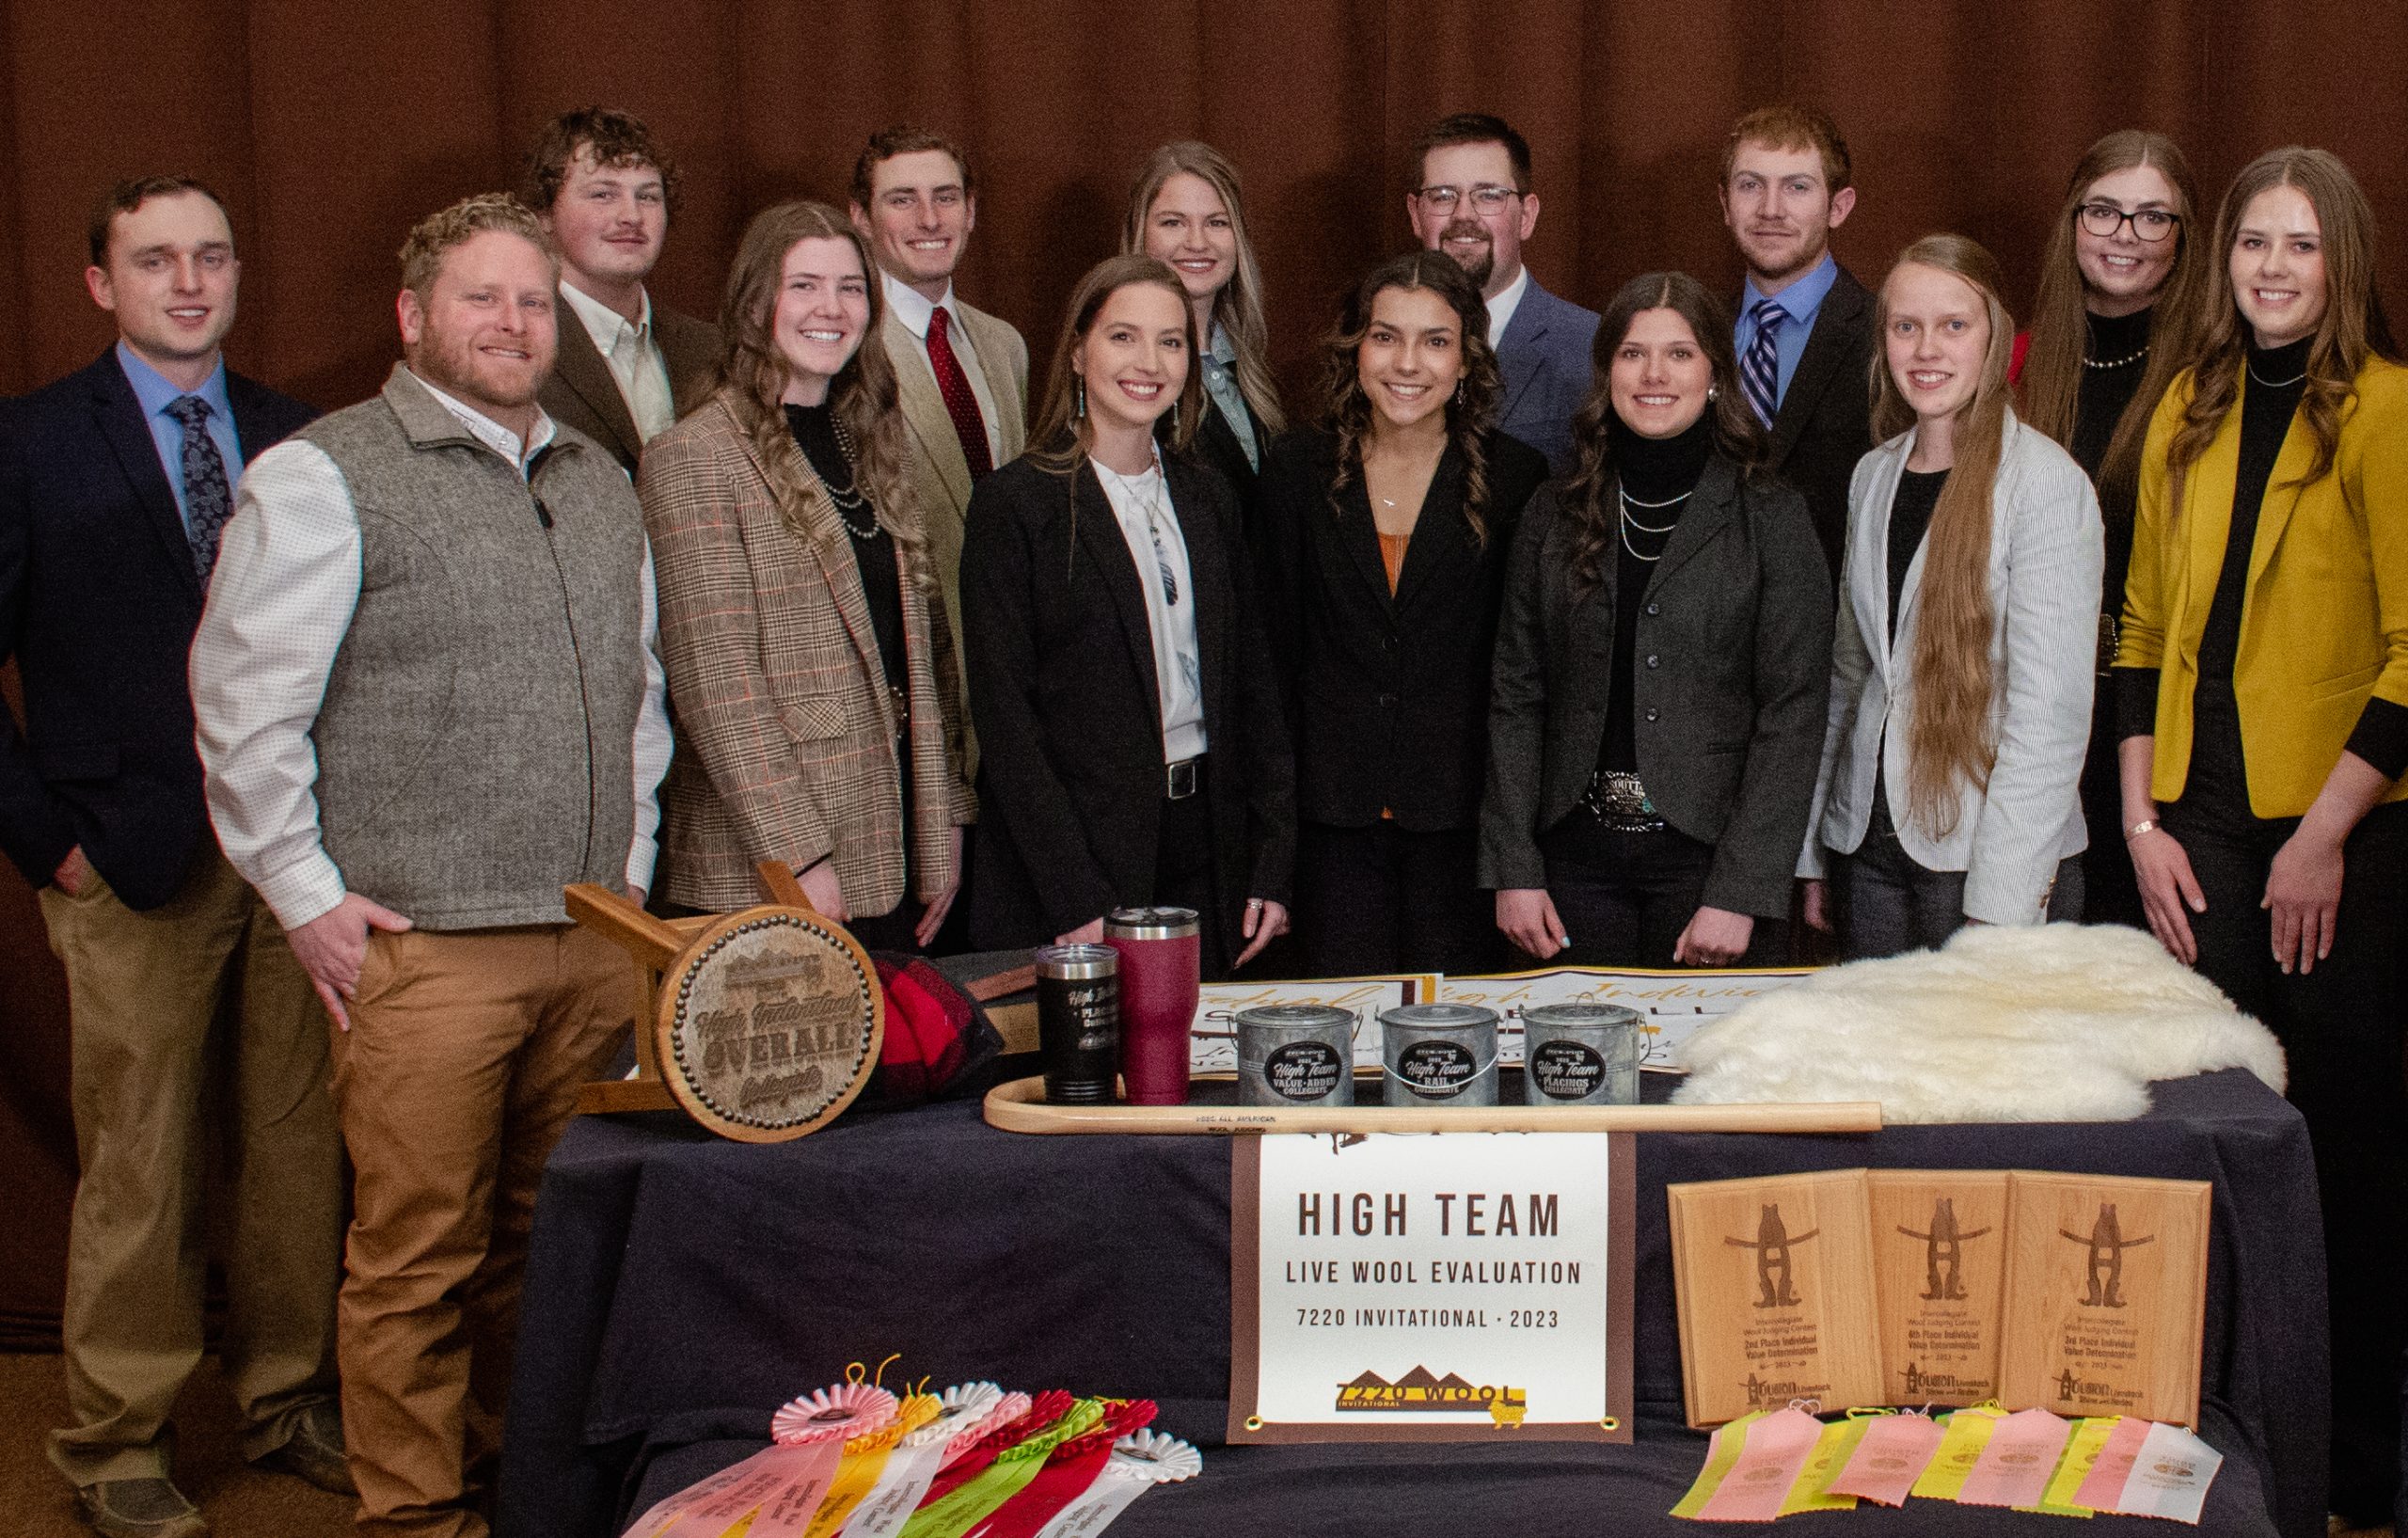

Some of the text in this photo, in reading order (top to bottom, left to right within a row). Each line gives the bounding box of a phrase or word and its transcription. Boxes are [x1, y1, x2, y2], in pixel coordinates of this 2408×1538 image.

[704, 1023, 855, 1074] OVERALL
[1273, 1061, 1337, 1081] High Team
[1405, 1061, 1471, 1080] High Team
[1537, 1060, 1599, 1078] High Team
[1298, 1192, 1559, 1237] HIGH TEAM
[1286, 1261, 1581, 1285] LIVE WOOL EVALUATION
[1296, 1308, 1559, 1328] 7220 INVITATIONAL 2023
[1337, 1383, 1514, 1402] 7220 WOOL
